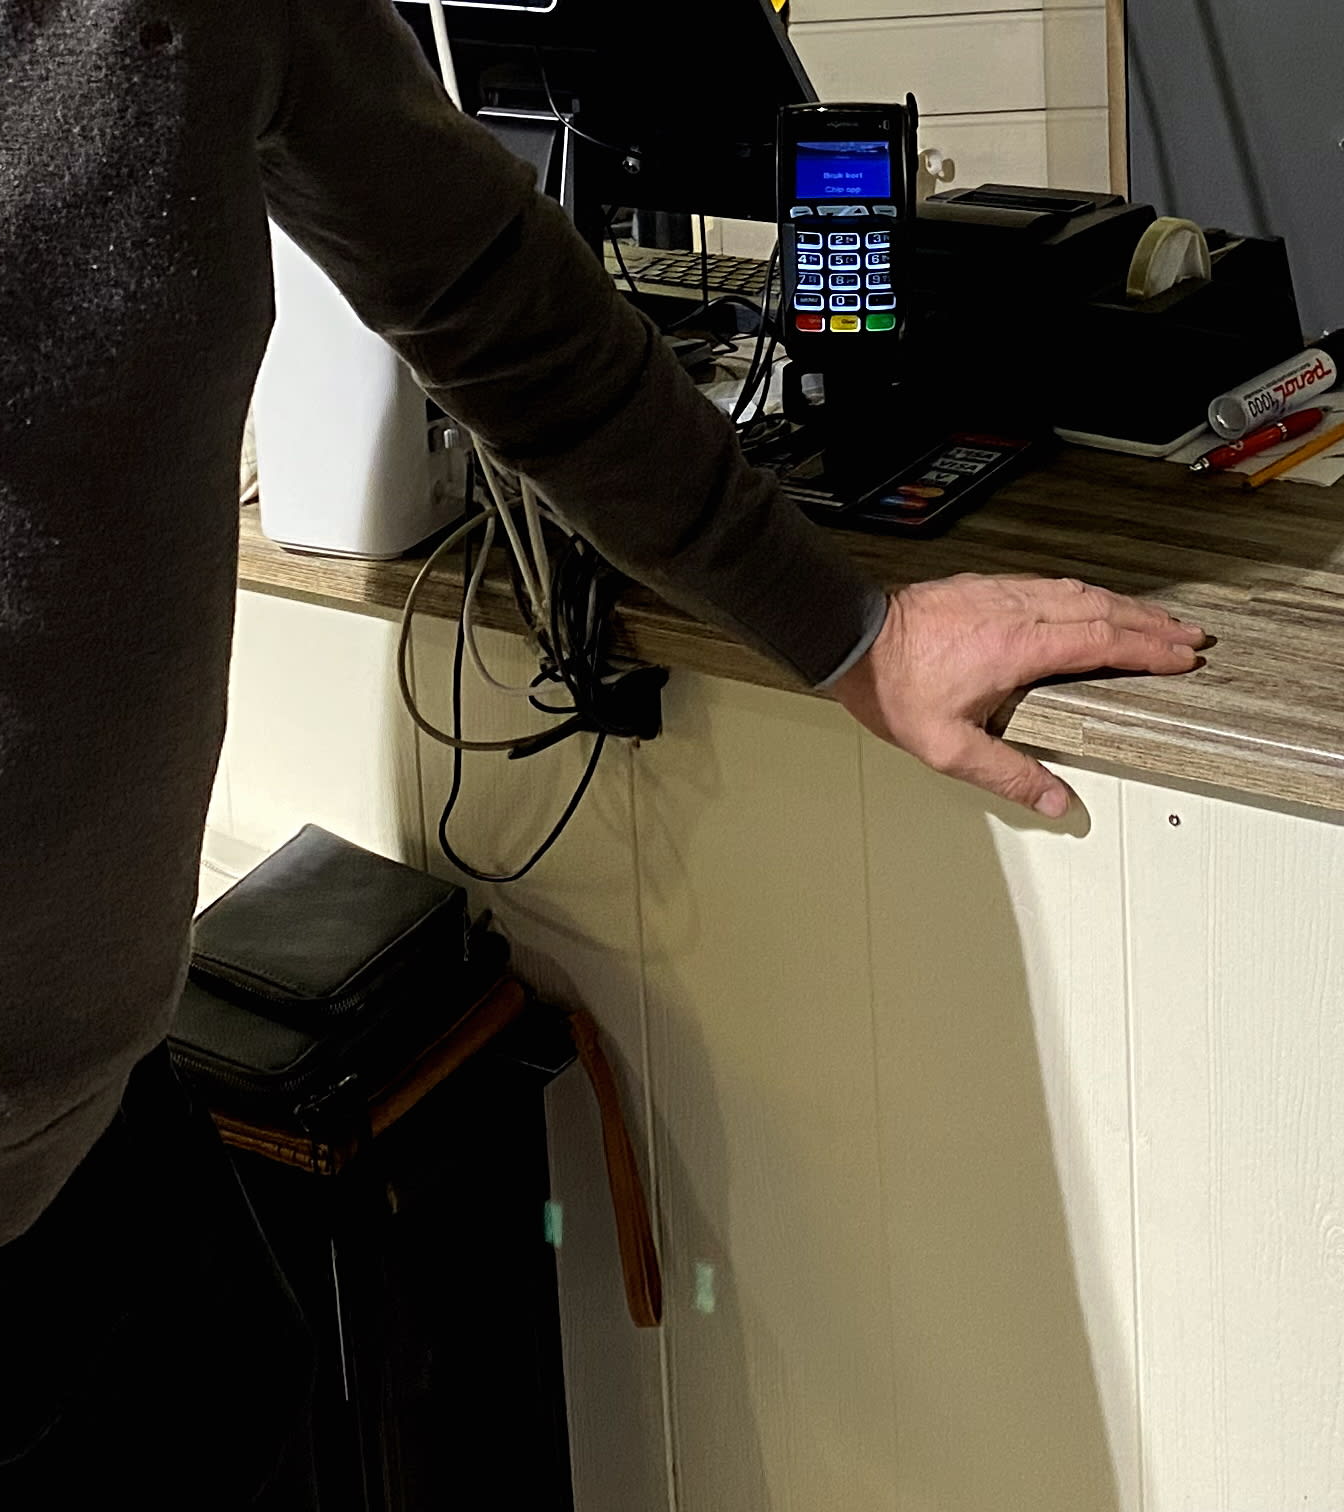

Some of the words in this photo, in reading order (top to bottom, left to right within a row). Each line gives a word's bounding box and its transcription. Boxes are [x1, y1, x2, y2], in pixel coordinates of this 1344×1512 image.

[835, 235, 843, 244] 2
[872, 233, 881, 243] 3
[797, 255, 807, 263] 4
[835, 255, 843, 265] 5
[871, 255, 880, 264] 6
